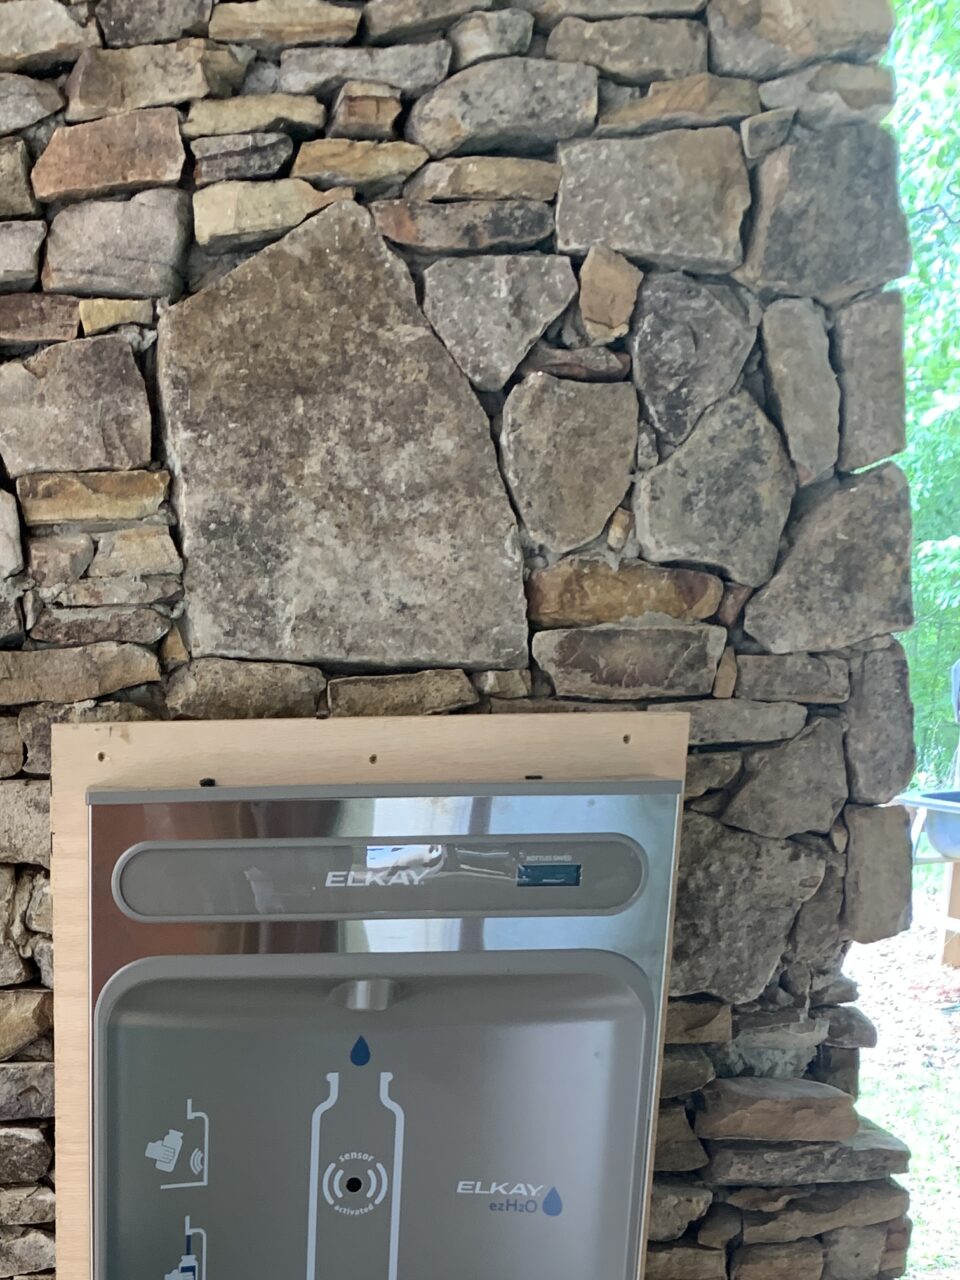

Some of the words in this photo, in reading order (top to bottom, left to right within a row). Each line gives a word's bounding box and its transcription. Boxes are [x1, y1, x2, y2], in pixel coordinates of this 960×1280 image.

[325, 869, 429, 887] ELKAY
[339, 1151, 375, 1163] sensor
[456, 1181, 544, 1197] ELKAY
[334, 1203, 374, 1216] activated
